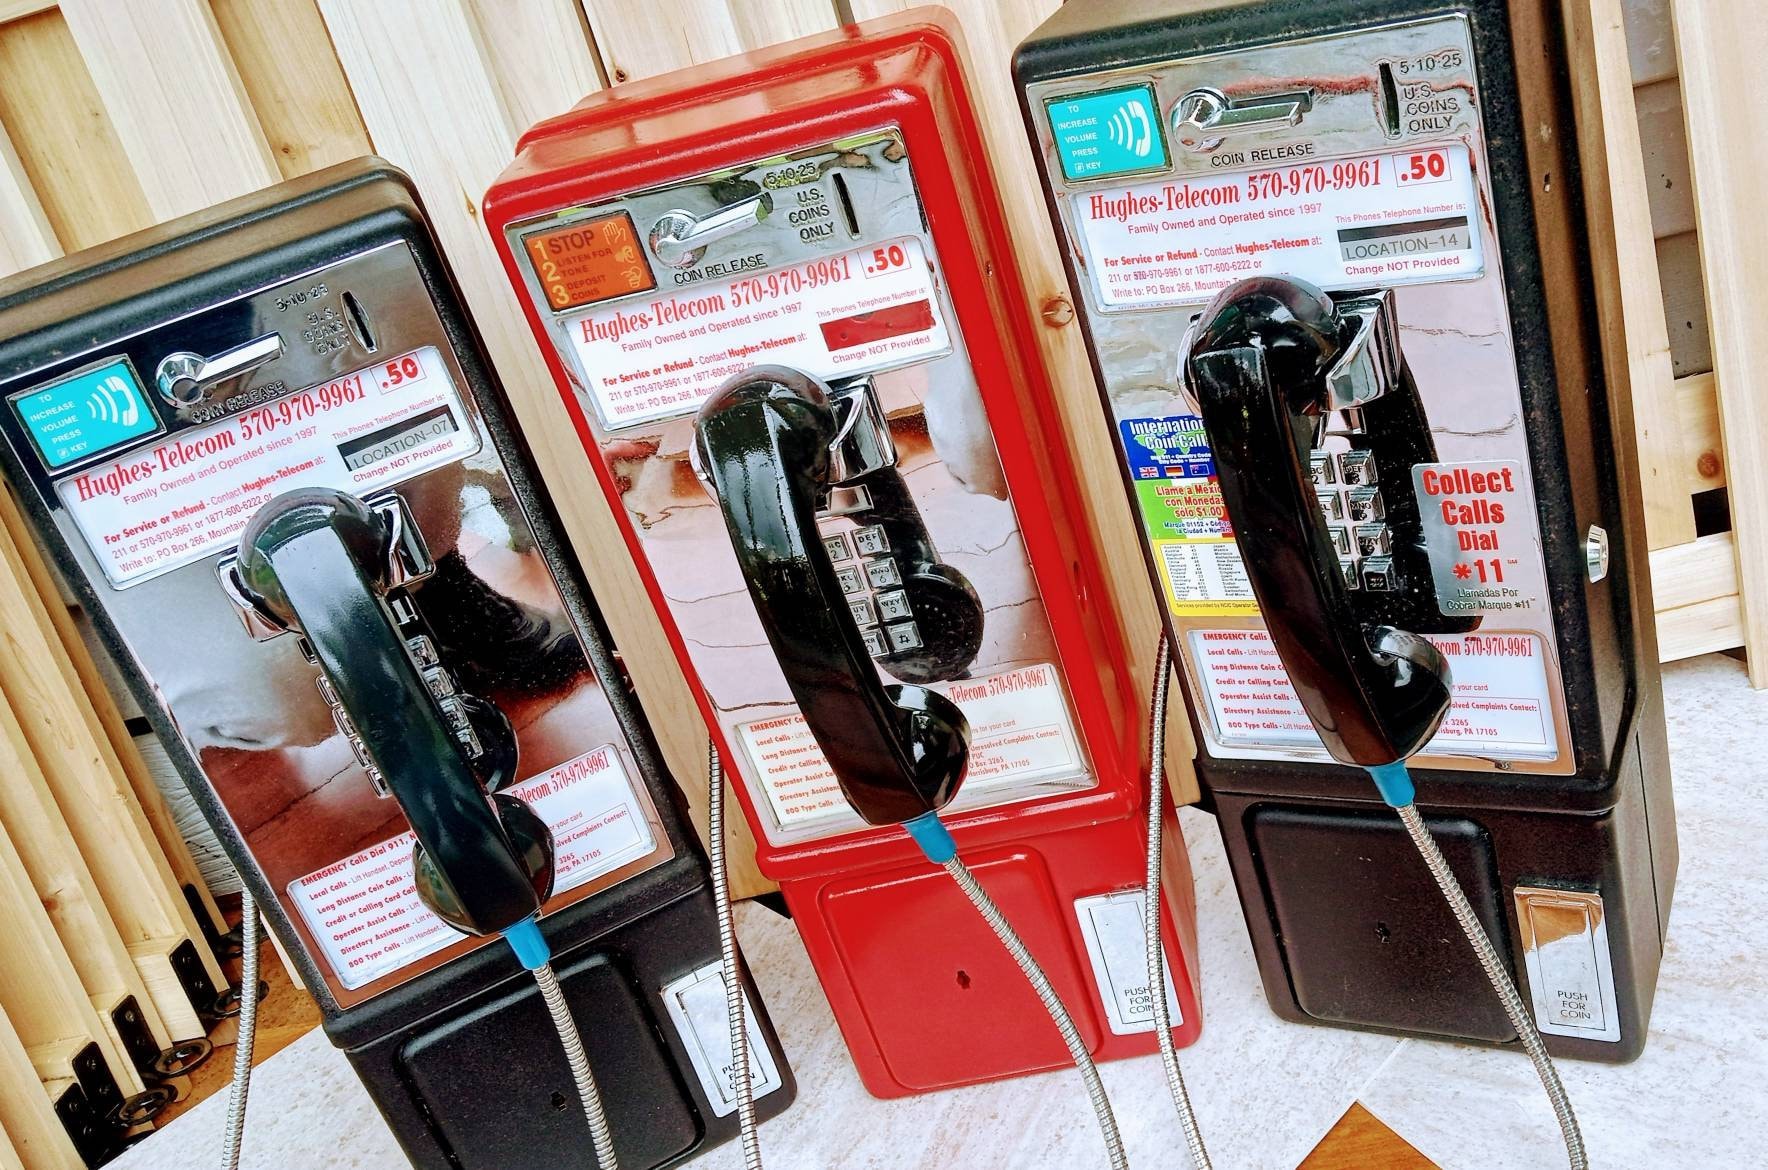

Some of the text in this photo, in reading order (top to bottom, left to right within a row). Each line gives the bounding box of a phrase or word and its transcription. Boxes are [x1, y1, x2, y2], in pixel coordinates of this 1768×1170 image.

[1404, 85, 1435, 100] U.S.
[1068, 105, 1079, 113] TO
[1407, 98, 1457, 115] COINS
[1057, 118, 1097, 129] INCREASE
[1409, 116, 1452, 132] ONLY
[1065, 132, 1097, 144] VOLUME
[1072, 147, 1098, 157] PRESS
[1211, 143, 1314, 167] COIN RELEASE
[1086, 161, 1101, 169] KEY
[1401, 153, 1445, 181] .50
[796, 188, 824, 203] U.S.
[1089, 159, 1380, 223] Hughes-Telecom 570-970-9961
[788, 204, 830, 223] COINS
[1128, 203, 1322, 234] Family Owned and Operated since 1997
[800, 221, 834, 240] ONLY
[535, 230, 594, 260] 1 STOP
[1104, 258, 1119, 267] For
[1121, 254, 1152, 265] Service
[1166, 248, 1198, 261] Refund
[1204, 246, 1234, 257] Contact
[1235, 238, 1310, 255] Hughes-Telecom
[1346, 234, 1458, 259] LOCATION-14
[543, 248, 613, 281] 2 LISTEN FOR
[868, 245, 904, 273] .50
[1185, 268, 1193, 276] or
[1195, 260, 1252, 274] 1877-600-6222
[1345, 256, 1460, 275] Change NOT Provided
[561, 265, 589, 276] TONE
[674, 253, 765, 285] COIN RELEASE
[552, 275, 606, 304] 3 DEPOSIT
[572, 289, 600, 300] COINS
[580, 256, 851, 343] Hughes-Telecom 570-970-9961
[621, 301, 802, 352] Family Owned and Operated since 1997
[832, 335, 930, 364] Change NOT Provided
[602, 378, 617, 387] For
[619, 370, 651, 383] Service
[663, 358, 694, 373] Refund
[699, 351, 728, 365] Contact
[727, 336, 796, 358] Hughes-Telecom
[382, 358, 418, 388] .50
[38, 394, 52, 403] TO
[226, 380, 288, 410] RELEASE
[30, 401, 75, 422] INCREASE
[41, 416, 79, 433] VOLUME
[1130, 418, 1204, 435] Internation
[52, 429, 81, 444] PRESS
[73, 376, 366, 502] Hughes-Telecom 570-970-9961
[353, 420, 446, 468] LOCATION-07
[1145, 434, 1209, 449] Coin Call
[71, 441, 88, 453] KEY
[123, 425, 316, 505] Family Owned and Operated since 1997
[353, 440, 453, 482] Change NOT Provided
[1422, 468, 1514, 495] Collect
[1156, 487, 1185, 496] Llame
[104, 534, 120, 544] For
[123, 521, 157, 538] Service
[160, 516, 170, 524] or
[171, 500, 206, 519] Refund
[210, 488, 243, 505] Contact
[241, 461, 314, 493] Hughes-Telecom
[1196, 507, 1222, 516] $1.00
[1441, 499, 1505, 525] Calls
[858, 535, 878, 543] DEF
[866, 542, 874, 551] 3
[1457, 530, 1498, 551] Dial
[1458, 588, 1518, 597] Llamadas Por
[1447, 600, 1476, 610] Cobrar
[1480, 600, 1512, 611] Marque
[1464, 637, 1532, 657] 570-970-9961
[988, 669, 1048, 696] 570-970-9961
[1219, 693, 1249, 701] Operator
[750, 718, 791, 732] EMERGENCY
[1476, 728, 1498, 736] 17105
[550, 750, 610, 792] 570-970-9961
[301, 838, 408, 886] EMERGENCY Calls Dial 911,
[572, 849, 601, 867] PA 17105
[1125, 987, 1150, 996] PUSH
[1130, 996, 1151, 1005] FOR
[1558, 991, 1588, 1000] PUSH
[1130, 1006, 1154, 1014] COIN
[1560, 1010, 1591, 1019] COIN
[1562, 1001, 1585, 1010] FOR
